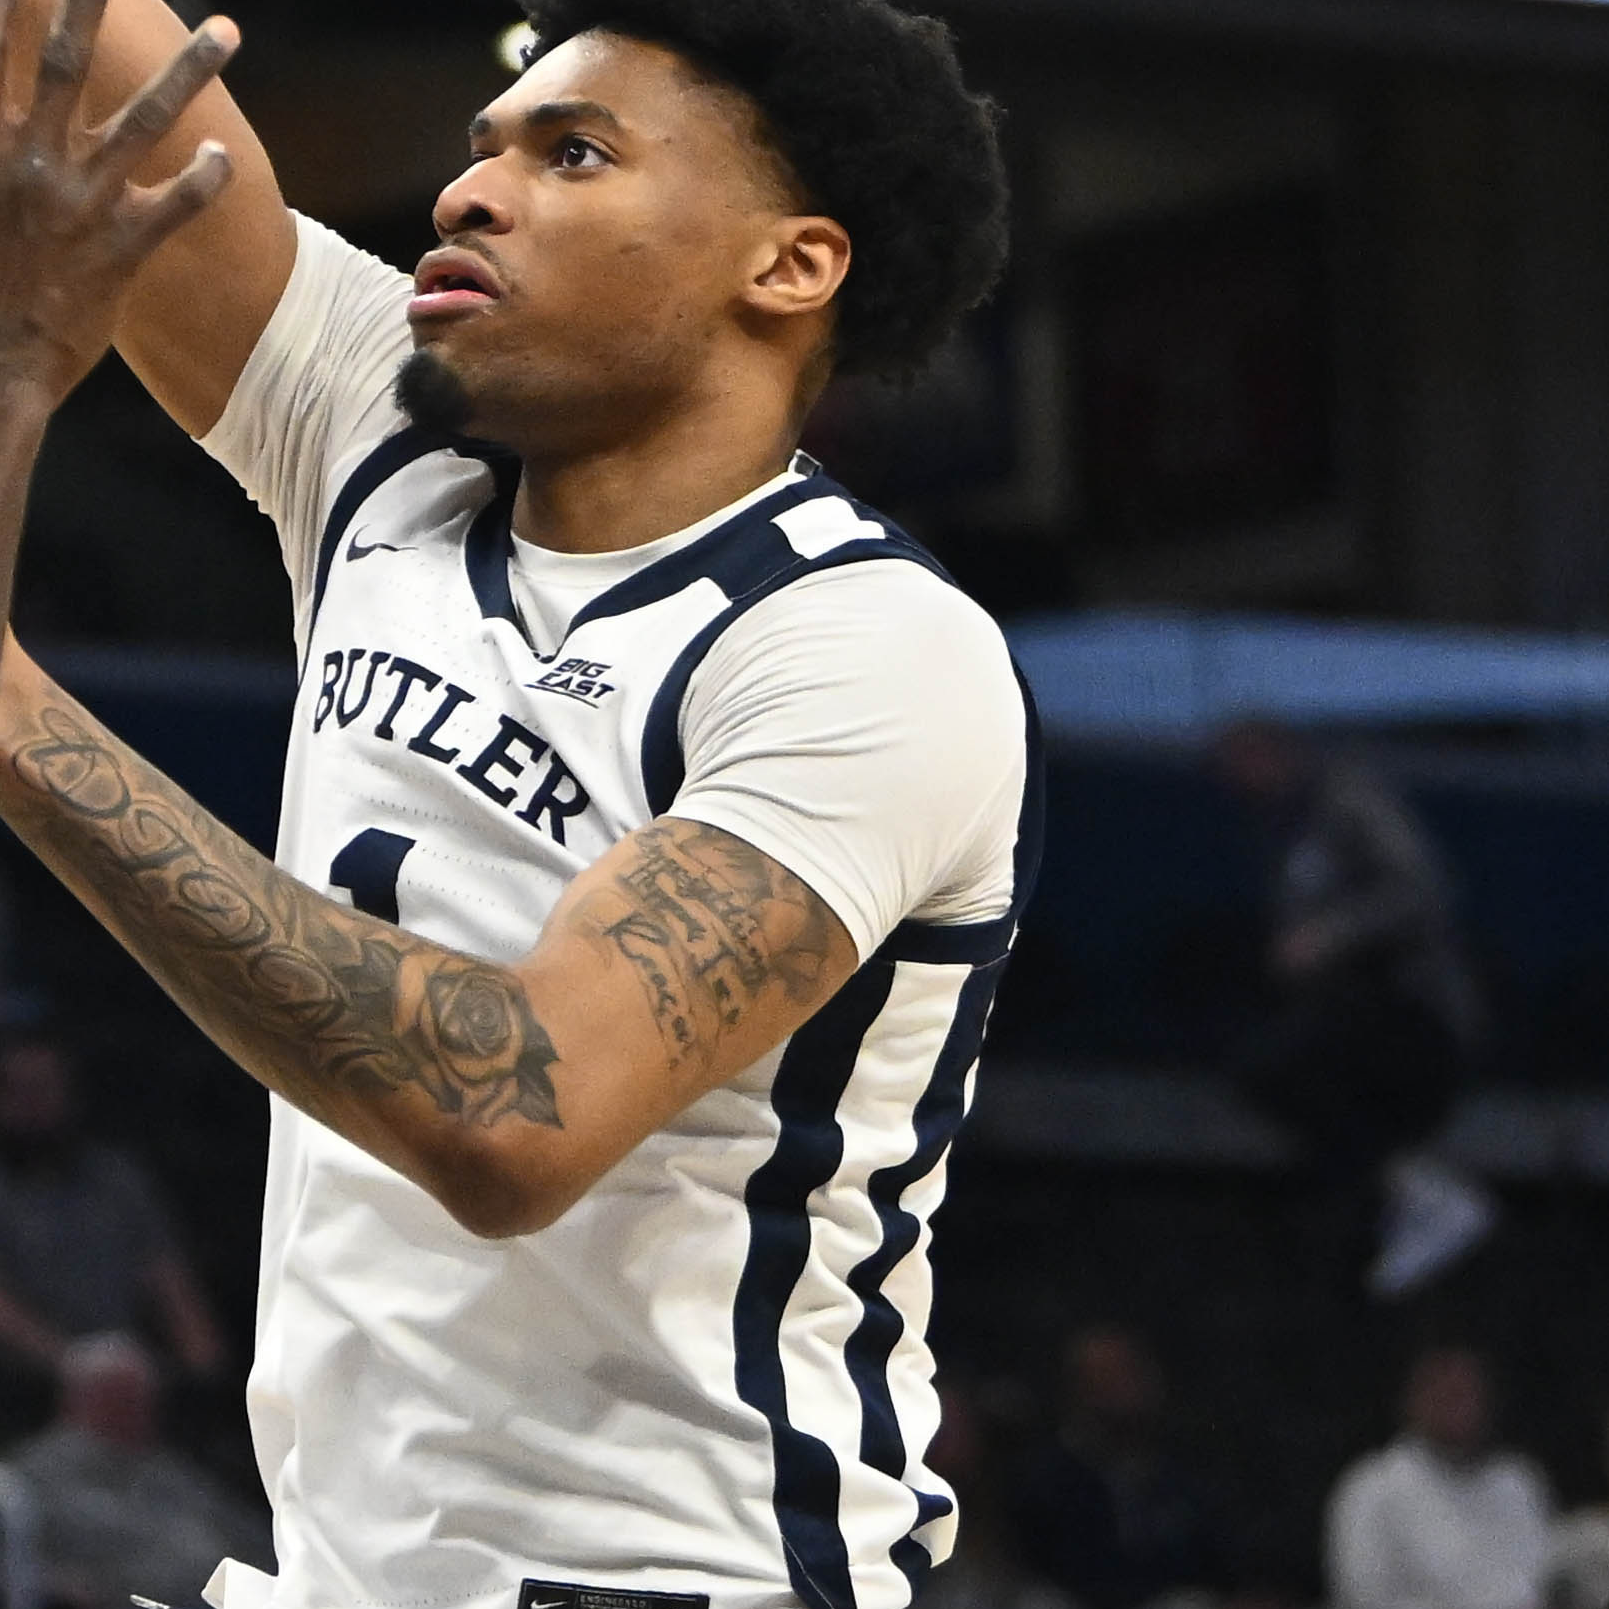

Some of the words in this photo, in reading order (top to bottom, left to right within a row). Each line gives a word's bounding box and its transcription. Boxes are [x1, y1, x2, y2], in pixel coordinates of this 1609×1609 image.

[553, 657, 614, 679] BIG
[535, 671, 617, 699] EAST
[313, 647, 589, 847] BUTLER
